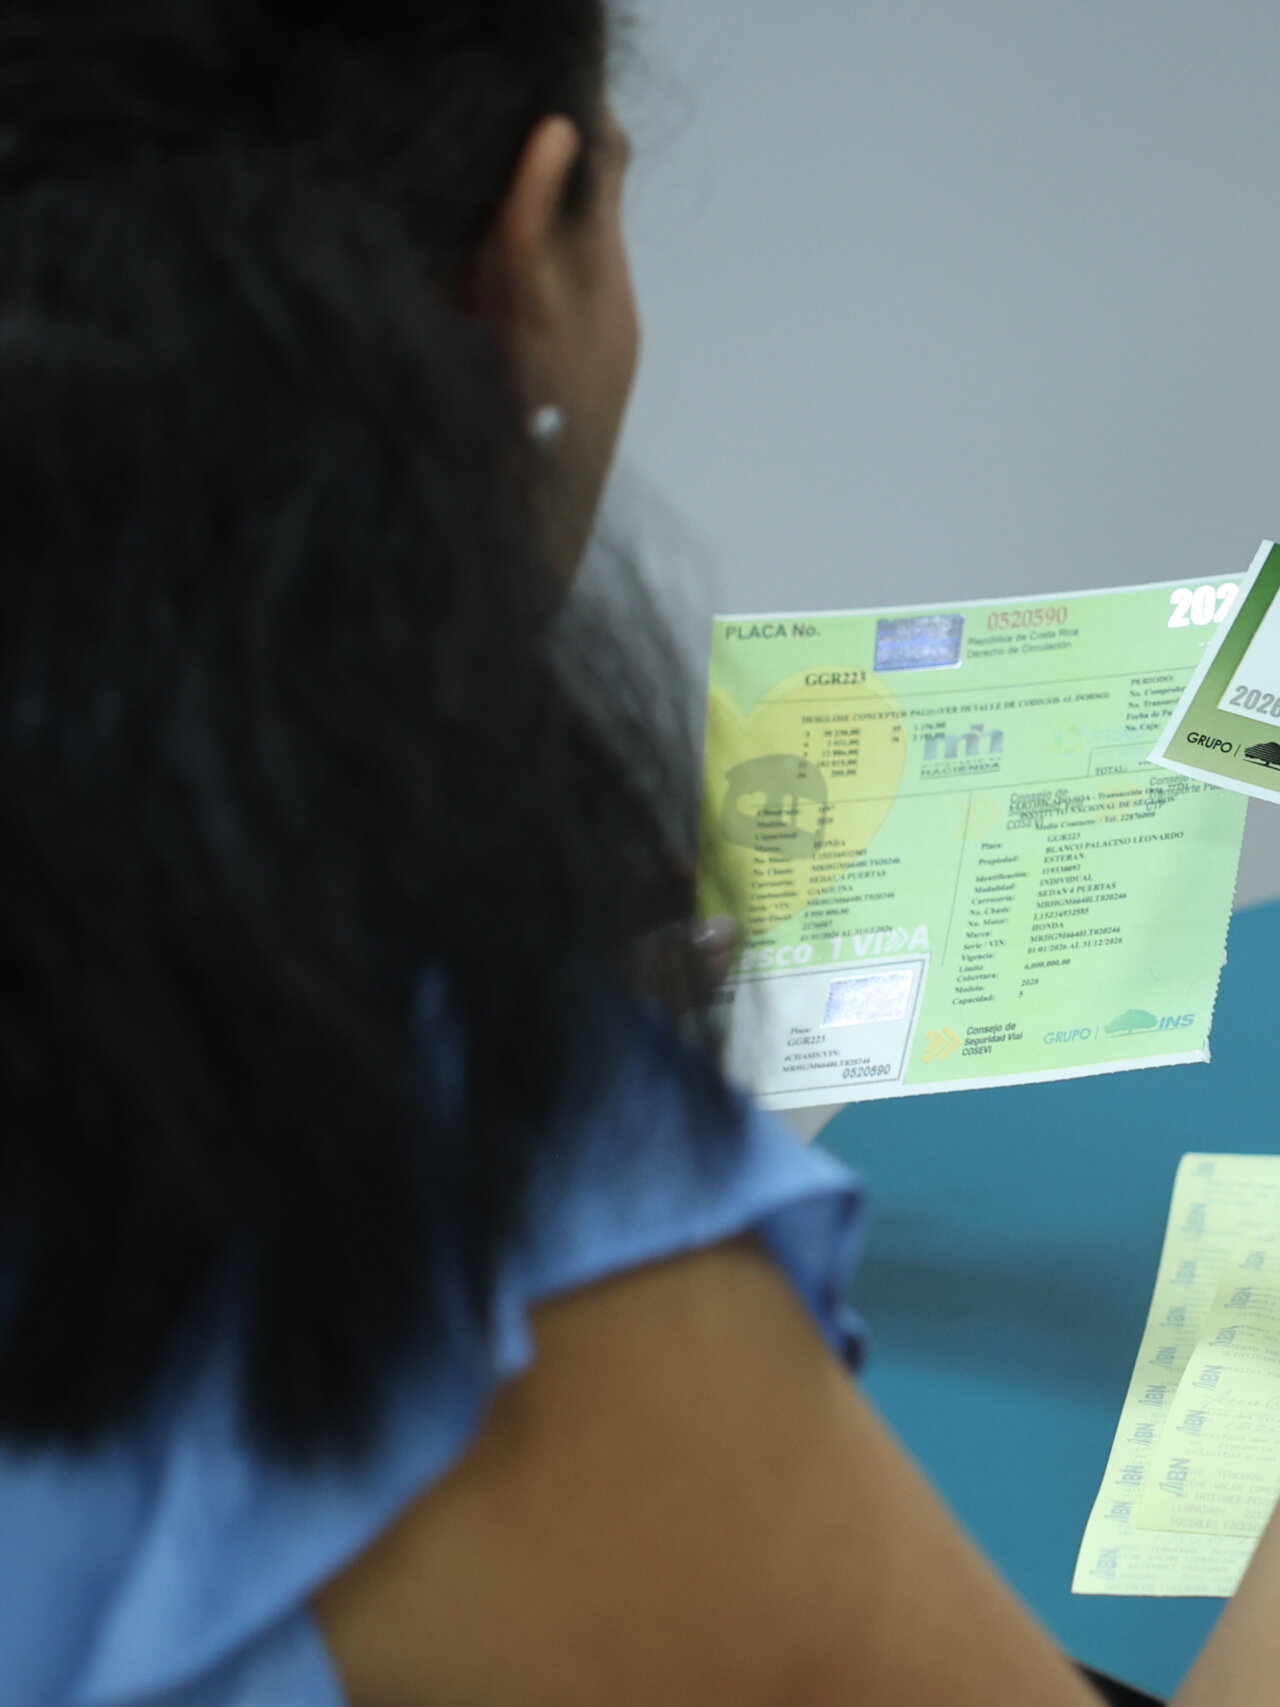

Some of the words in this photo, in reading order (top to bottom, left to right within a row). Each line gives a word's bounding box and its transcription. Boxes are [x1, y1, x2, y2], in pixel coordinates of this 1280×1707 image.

[987, 606, 1068, 631] 0520590
[725, 624, 787, 640] PLACA
[792, 624, 822, 638] No.
[1016, 633, 1027, 642] de
[1030, 630, 1056, 640] Costa
[1059, 628, 1079, 637] Rica
[967, 647, 1005, 659] Derecho
[804, 671, 866, 687] GGR223
[1186, 731, 1233, 753] GRUPO
[1045, 843, 1083, 854] BLANCO
[1085, 837, 1131, 850] PALACINO
[1133, 831, 1185, 844] LEONARDO
[1047, 832, 1081, 843] GGR223
[1044, 853, 1085, 864] ESTEBAN
[1039, 874, 1094, 887] INDIVIDUAL
[1037, 887, 1068, 898] SEDAN
[1076, 882, 1117, 894] PUERTAS
[1031, 921, 1064, 932] HONDA
[829, 935, 844, 960] 1
[1021, 977, 1039, 987] 2020
[966, 1023, 1002, 1036] Consejo
[1005, 1021, 1017, 1031] de
[1043, 1027, 1092, 1045] GRUPO
[1157, 1012, 1196, 1031] INS
[787, 1035, 827, 1047] GGR223
[964, 1033, 1006, 1046] Seguridad
[1008, 1031, 1024, 1041] Vial
[961, 1045, 992, 1056] COSEVI
[842, 1063, 891, 1079] 0520590
